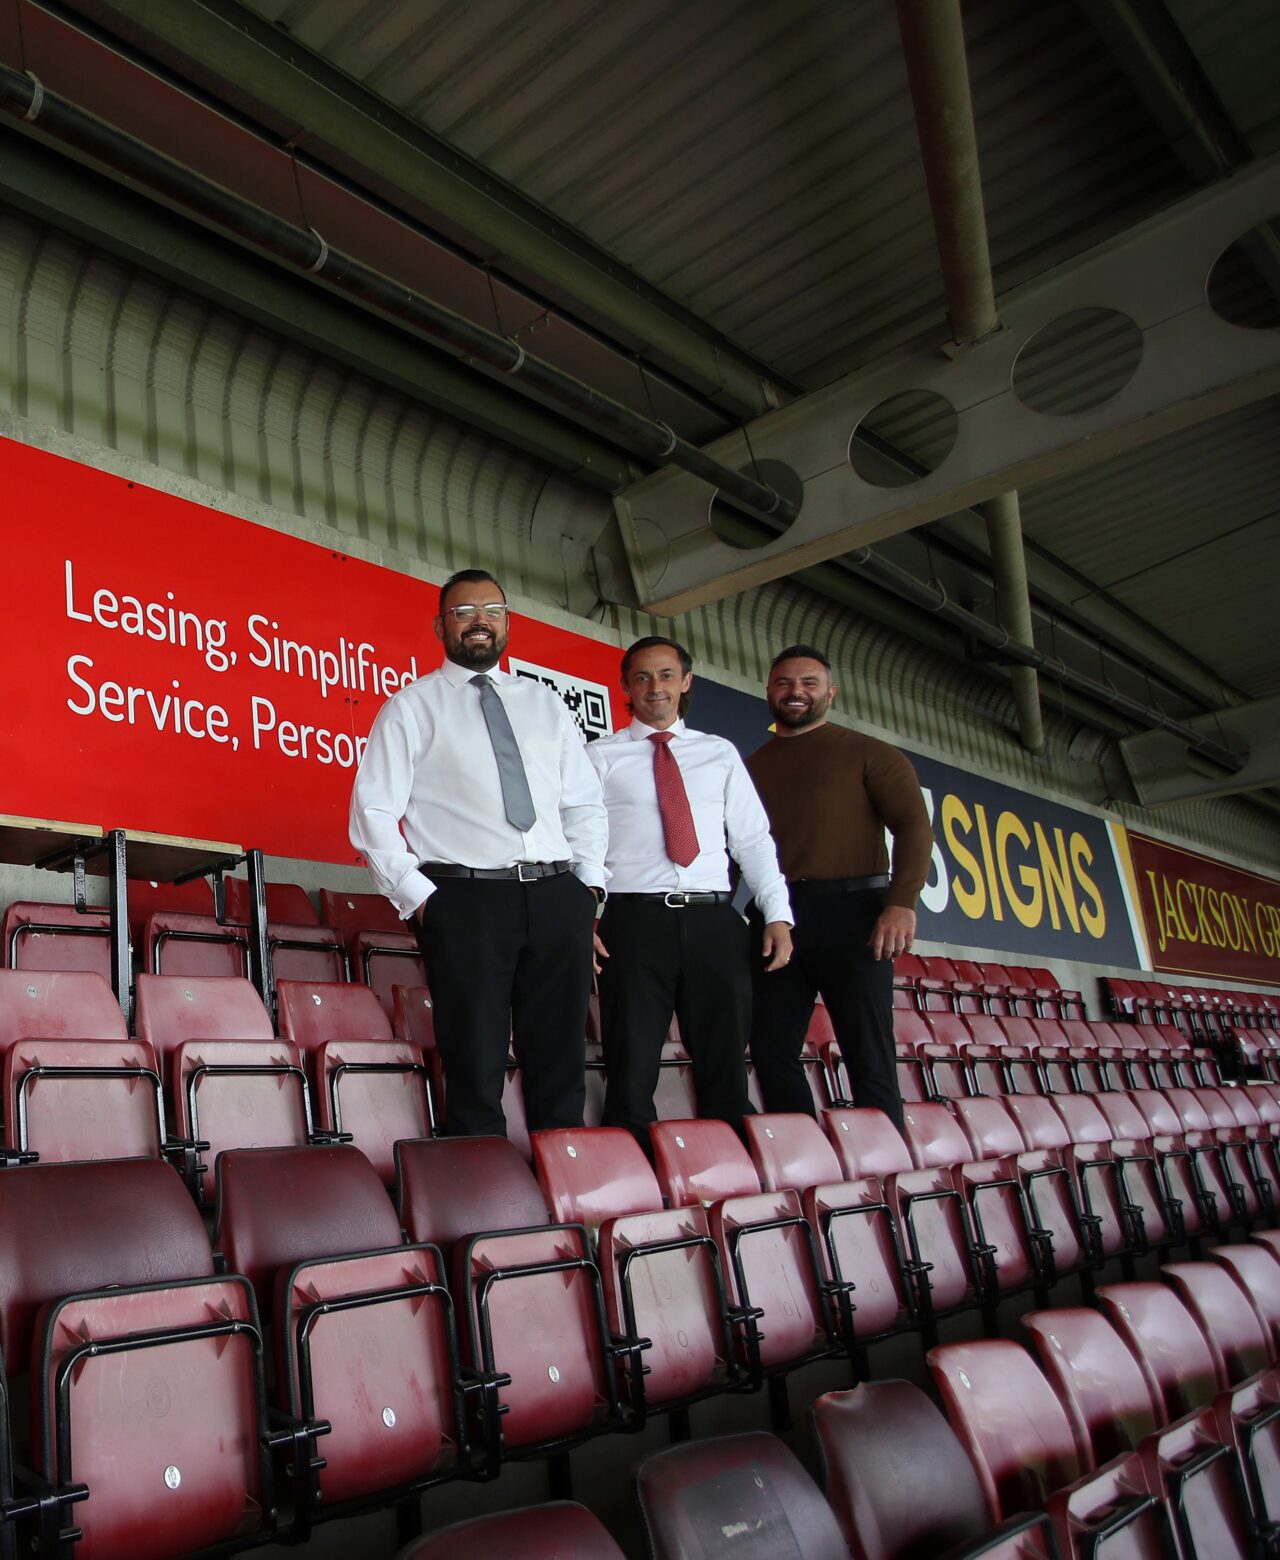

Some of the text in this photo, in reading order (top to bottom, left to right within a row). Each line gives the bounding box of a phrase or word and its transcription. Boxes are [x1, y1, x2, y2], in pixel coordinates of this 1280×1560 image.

[65, 560, 237, 672] Leasing,
[67, 655, 239, 751] Service,
[1145, 870, 1280, 959] JACKSON GR
